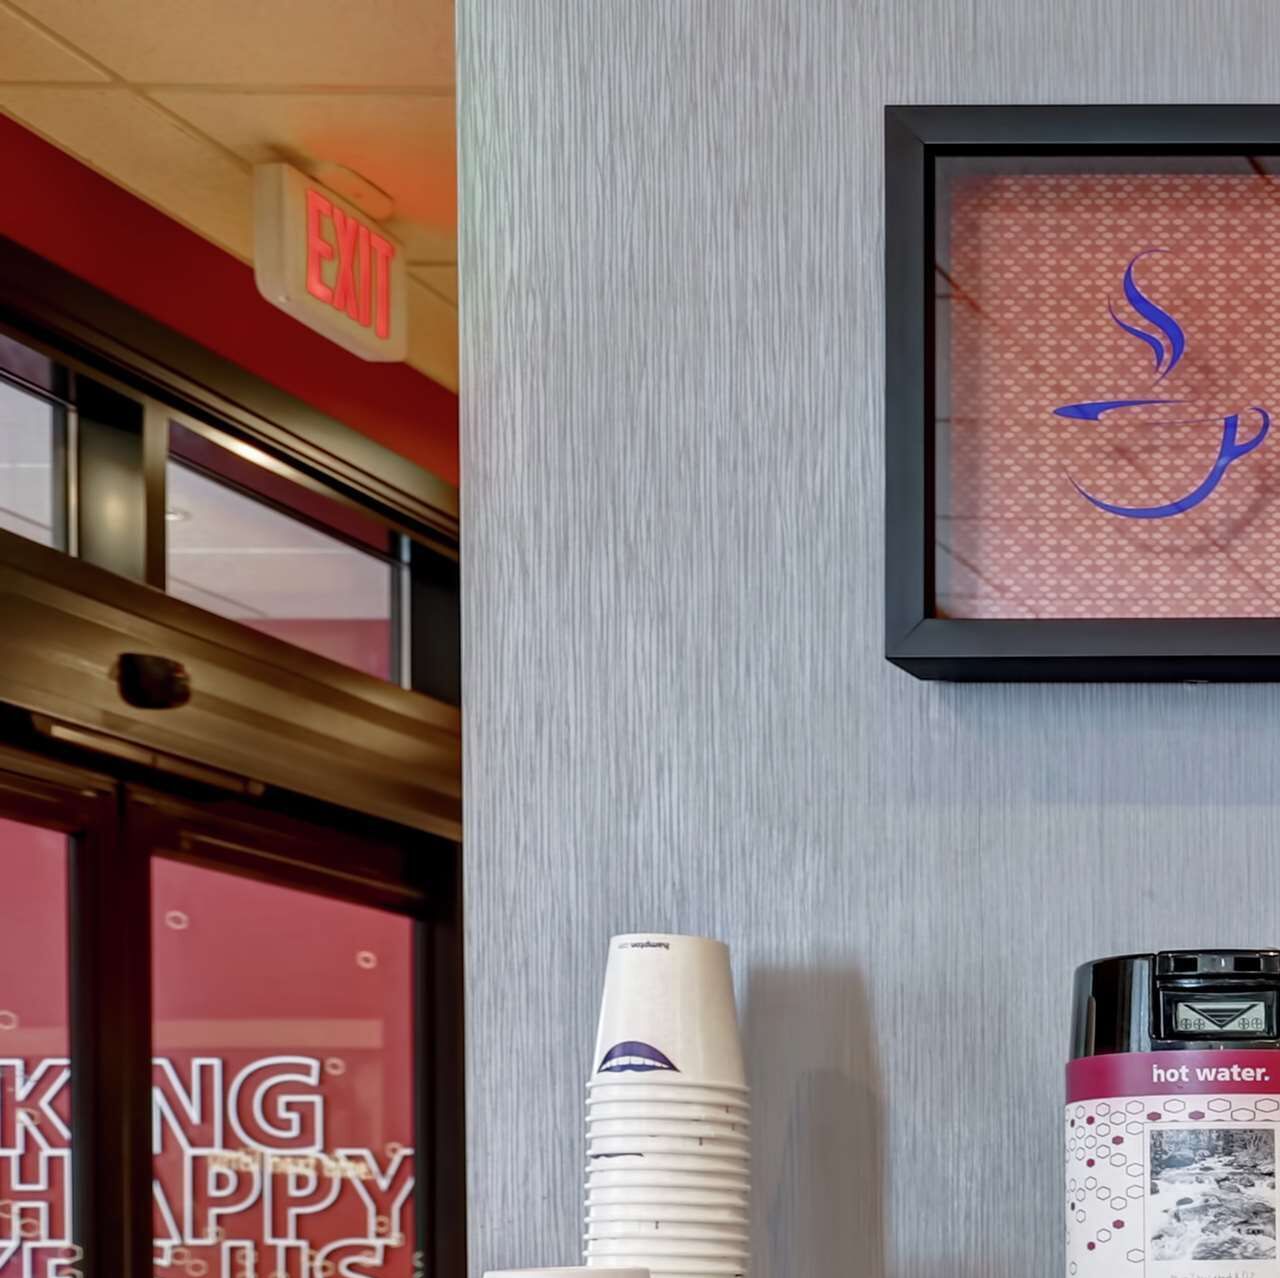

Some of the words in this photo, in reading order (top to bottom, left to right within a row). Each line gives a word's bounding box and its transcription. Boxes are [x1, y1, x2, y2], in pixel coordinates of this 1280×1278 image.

[306, 187, 396, 340] EXIT
[1153, 1064, 1189, 1082] hot
[1196, 1064, 1270, 1081] water.
